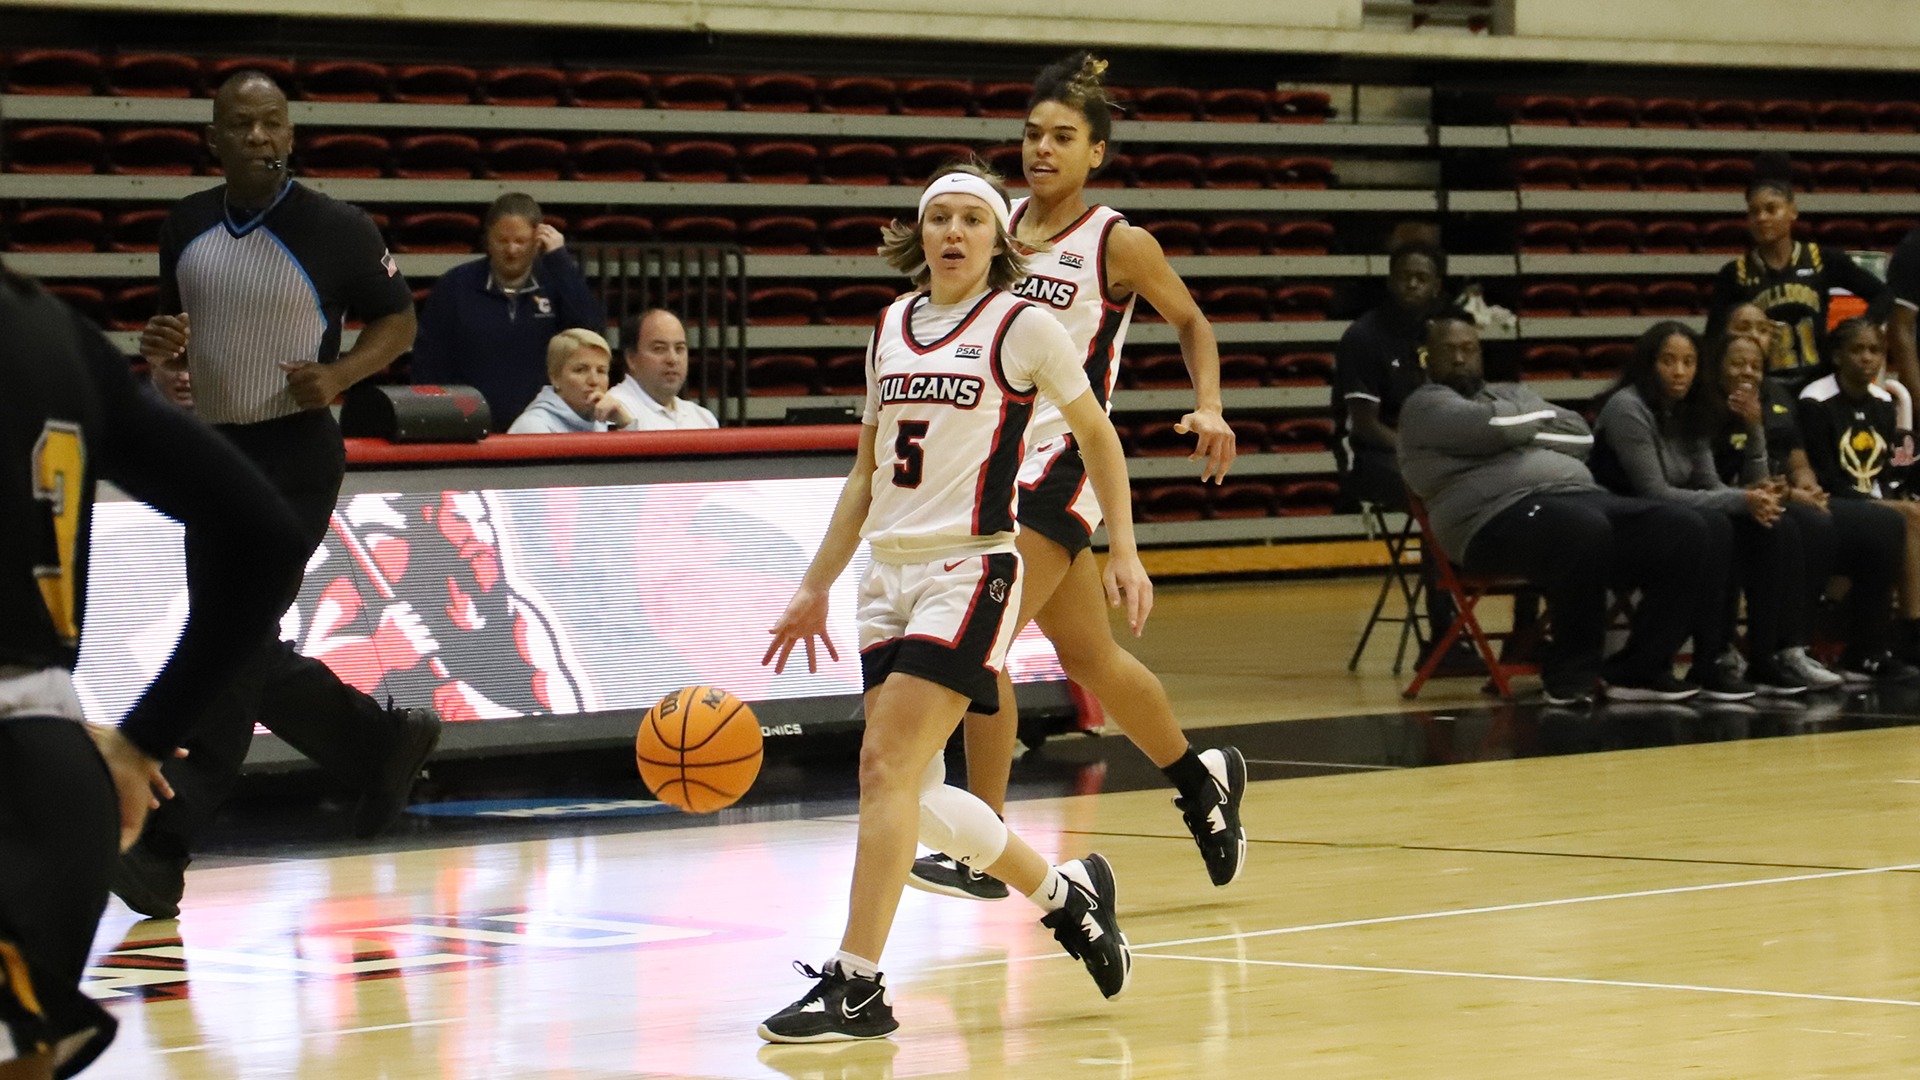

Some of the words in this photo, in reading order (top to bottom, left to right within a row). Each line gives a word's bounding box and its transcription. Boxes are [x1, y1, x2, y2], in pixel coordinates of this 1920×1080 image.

[1060, 253, 1084, 267] PSAC
[956, 346, 982, 357] PSAC
[892, 420, 930, 490] 5
[761, 723, 803, 737] ONICS
